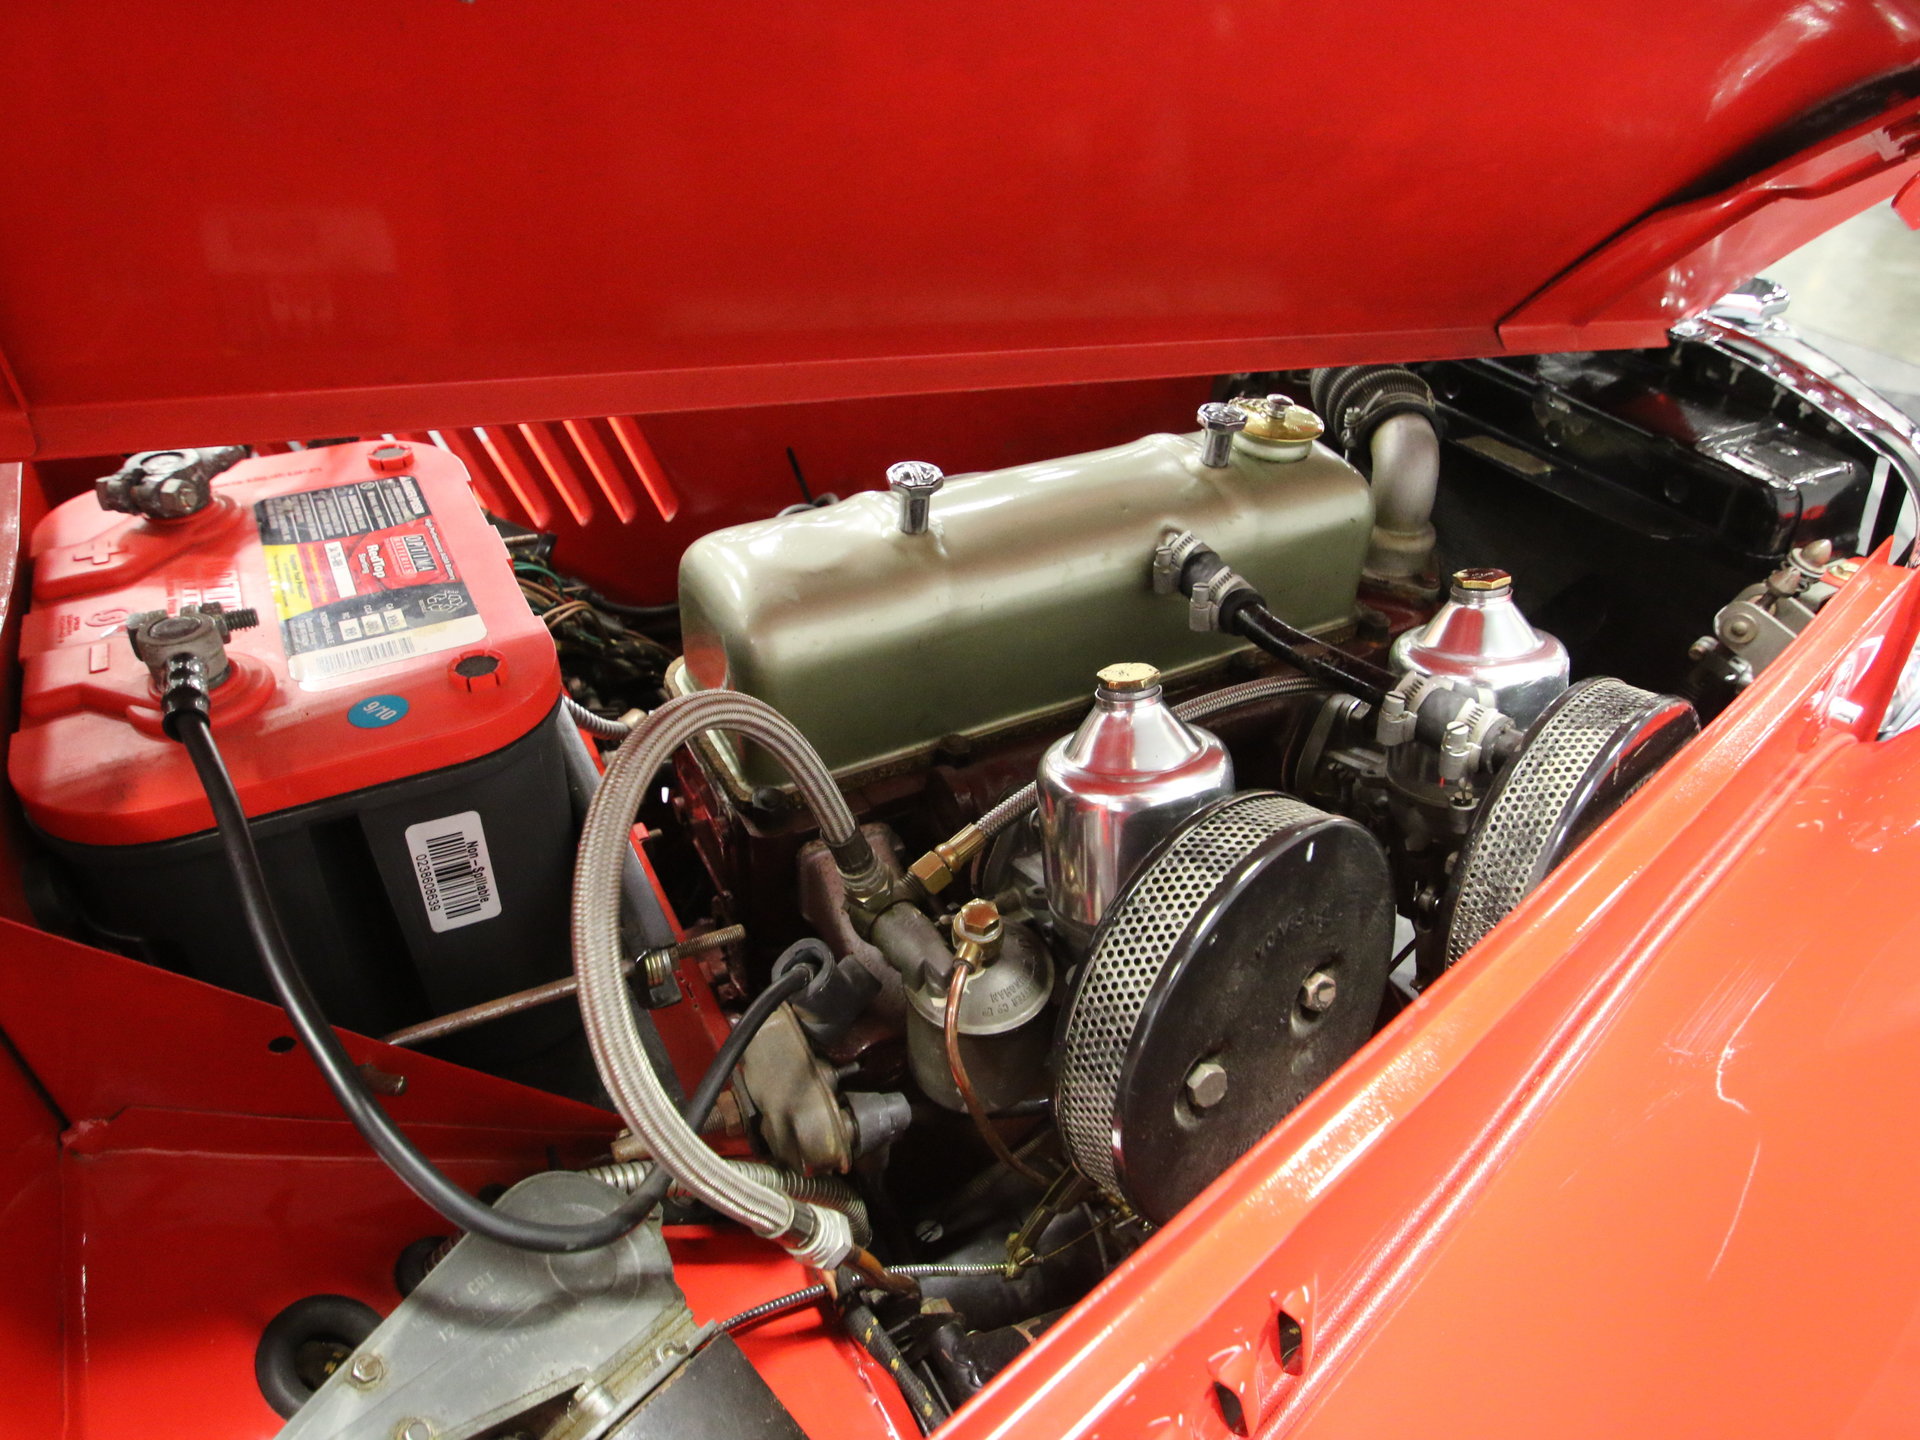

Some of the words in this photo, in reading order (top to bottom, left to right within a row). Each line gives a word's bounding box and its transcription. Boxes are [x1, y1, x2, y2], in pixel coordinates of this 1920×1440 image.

[366, 544, 386, 578] RedTop
[392, 537, 414, 575] BATTERIES
[404, 534, 436, 572] OPTIMA
[363, 701, 397, 720] 9/10
[416, 853, 440, 912] 0238608639
[466, 841, 490, 903] Non-Spillable
